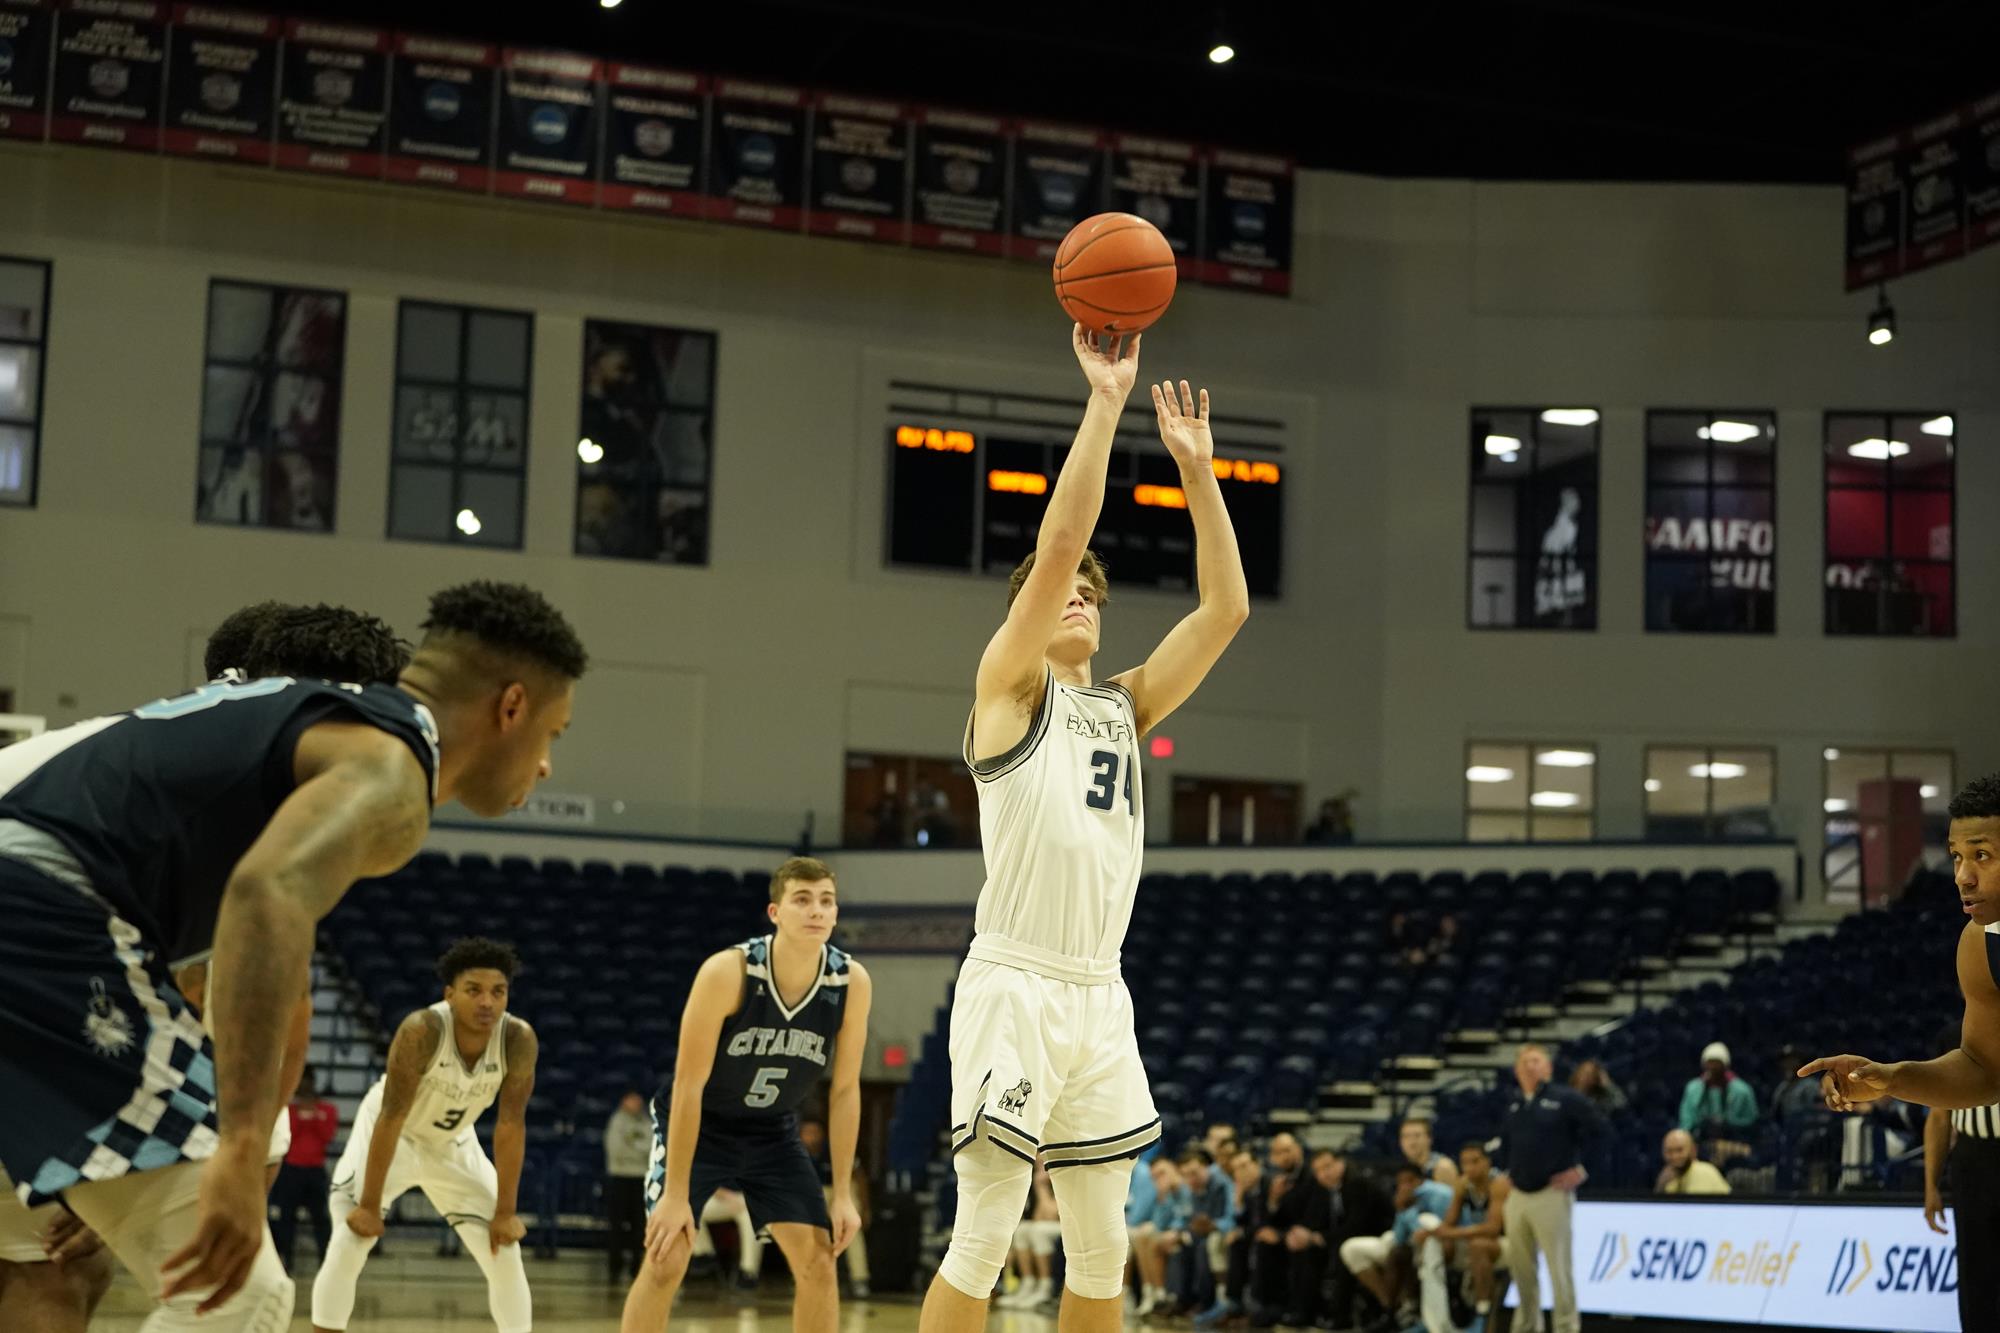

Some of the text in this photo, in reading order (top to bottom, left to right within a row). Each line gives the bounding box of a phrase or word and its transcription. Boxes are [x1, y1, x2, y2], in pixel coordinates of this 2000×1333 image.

[744, 1066, 789, 1109] 5
[1630, 1237, 1800, 1288] SEND Relief
